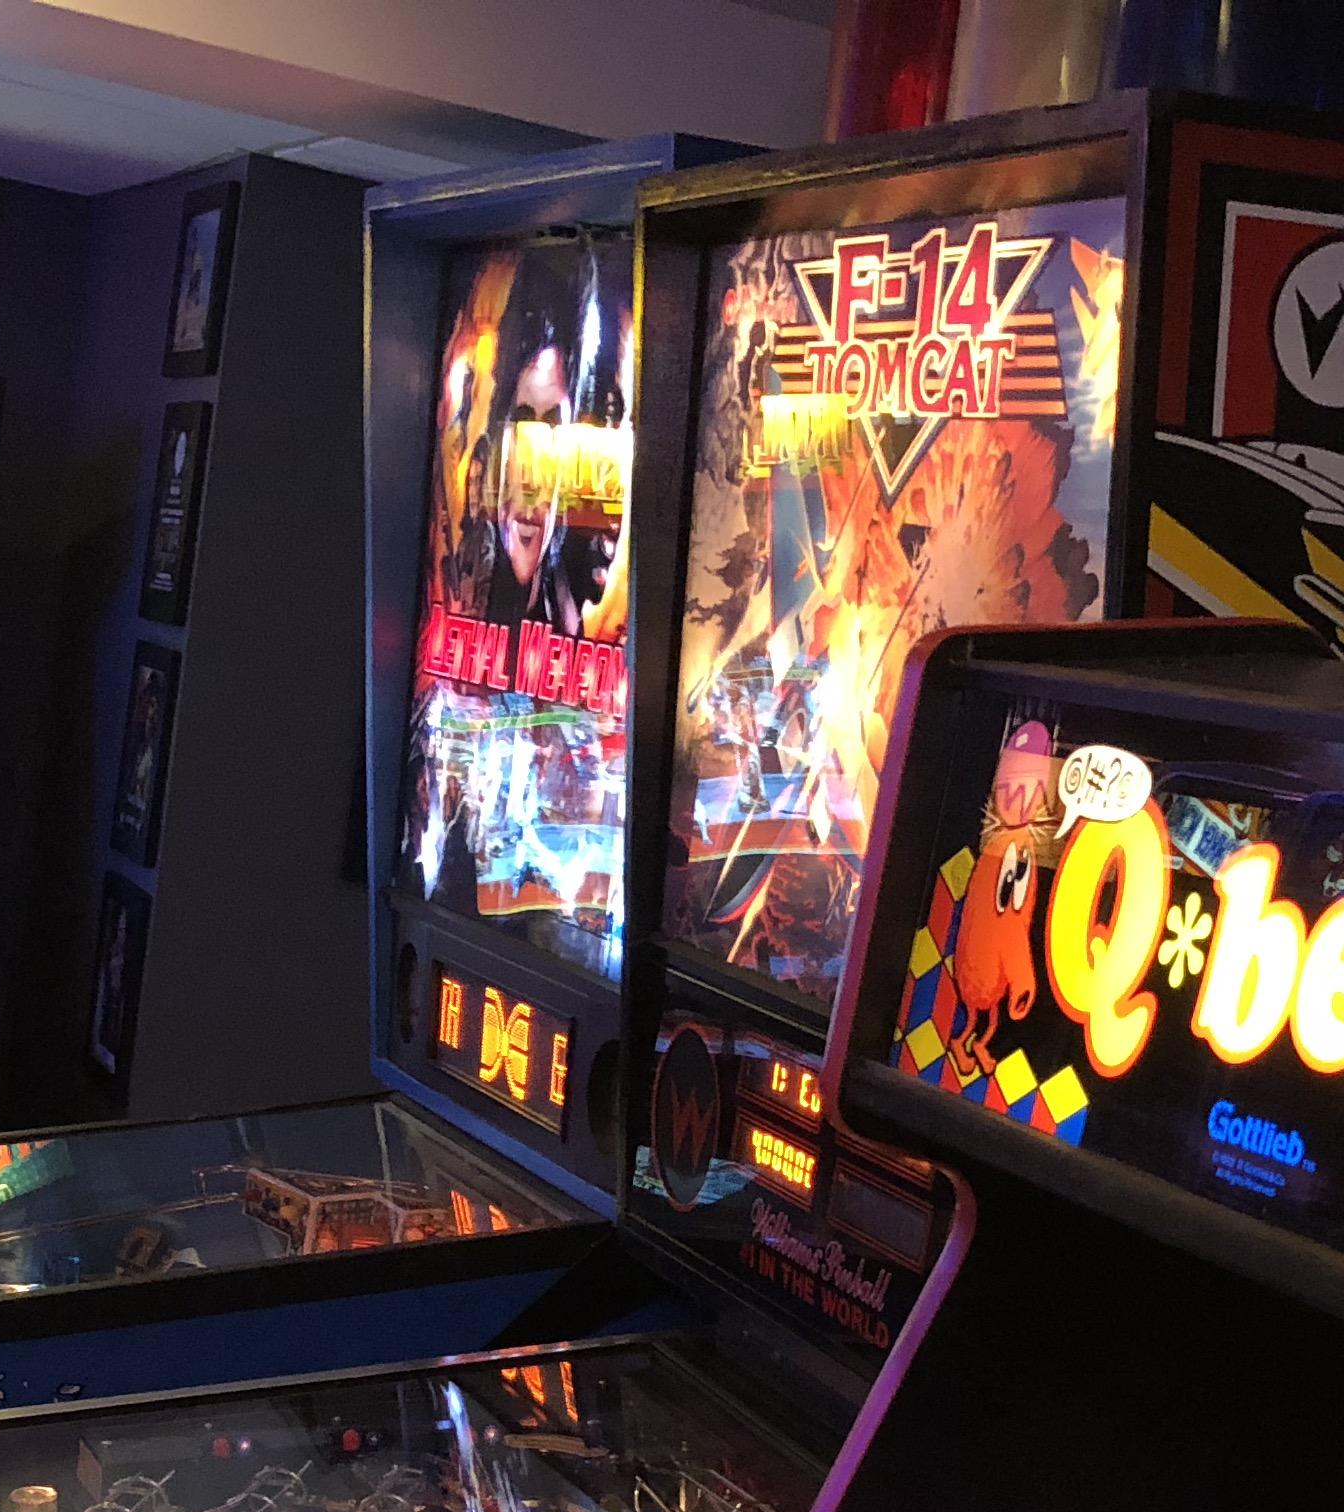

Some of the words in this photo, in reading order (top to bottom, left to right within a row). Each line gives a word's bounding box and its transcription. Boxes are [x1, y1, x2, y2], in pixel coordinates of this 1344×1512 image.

[833, 222, 998, 345] F-14
[804, 334, 1017, 418] TOMCAT
[423, 603, 509, 690] LETHAL
[1208, 1099, 1305, 1167] Gottlieb
[752, 1198, 823, 1276] Williams
[822, 1242, 892, 1312] Pinball
[759, 1251, 777, 1280] IN
[783, 1262, 815, 1305] THE
[821, 1286, 890, 1349] WORLD
